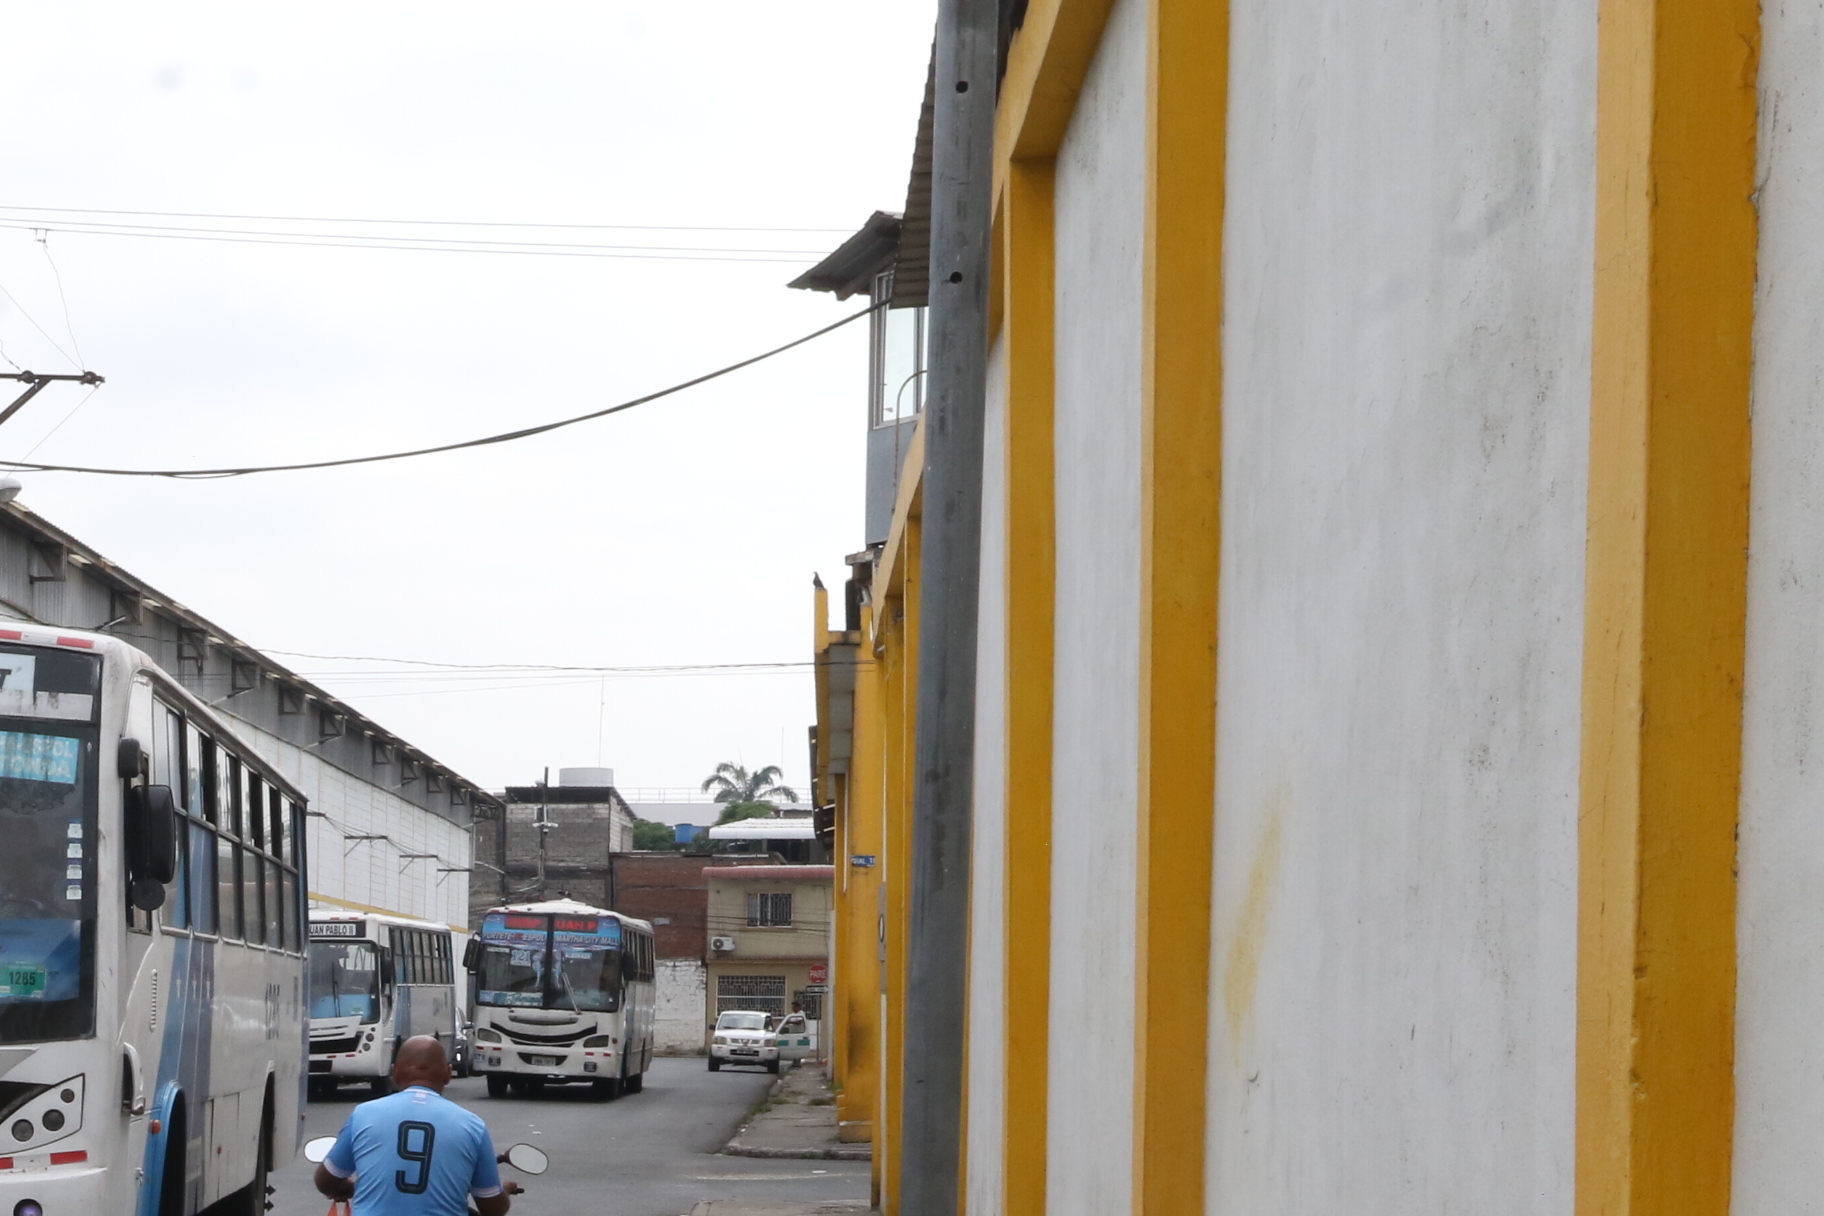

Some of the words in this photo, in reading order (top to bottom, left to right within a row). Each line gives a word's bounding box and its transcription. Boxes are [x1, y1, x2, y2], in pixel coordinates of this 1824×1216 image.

[309, 925, 324, 935] UAN
[325, 924, 348, 935] PABLO
[9, 971, 36, 986] 1285
[809, 969, 826, 979] PARE
[395, 1120, 436, 1195] 9
